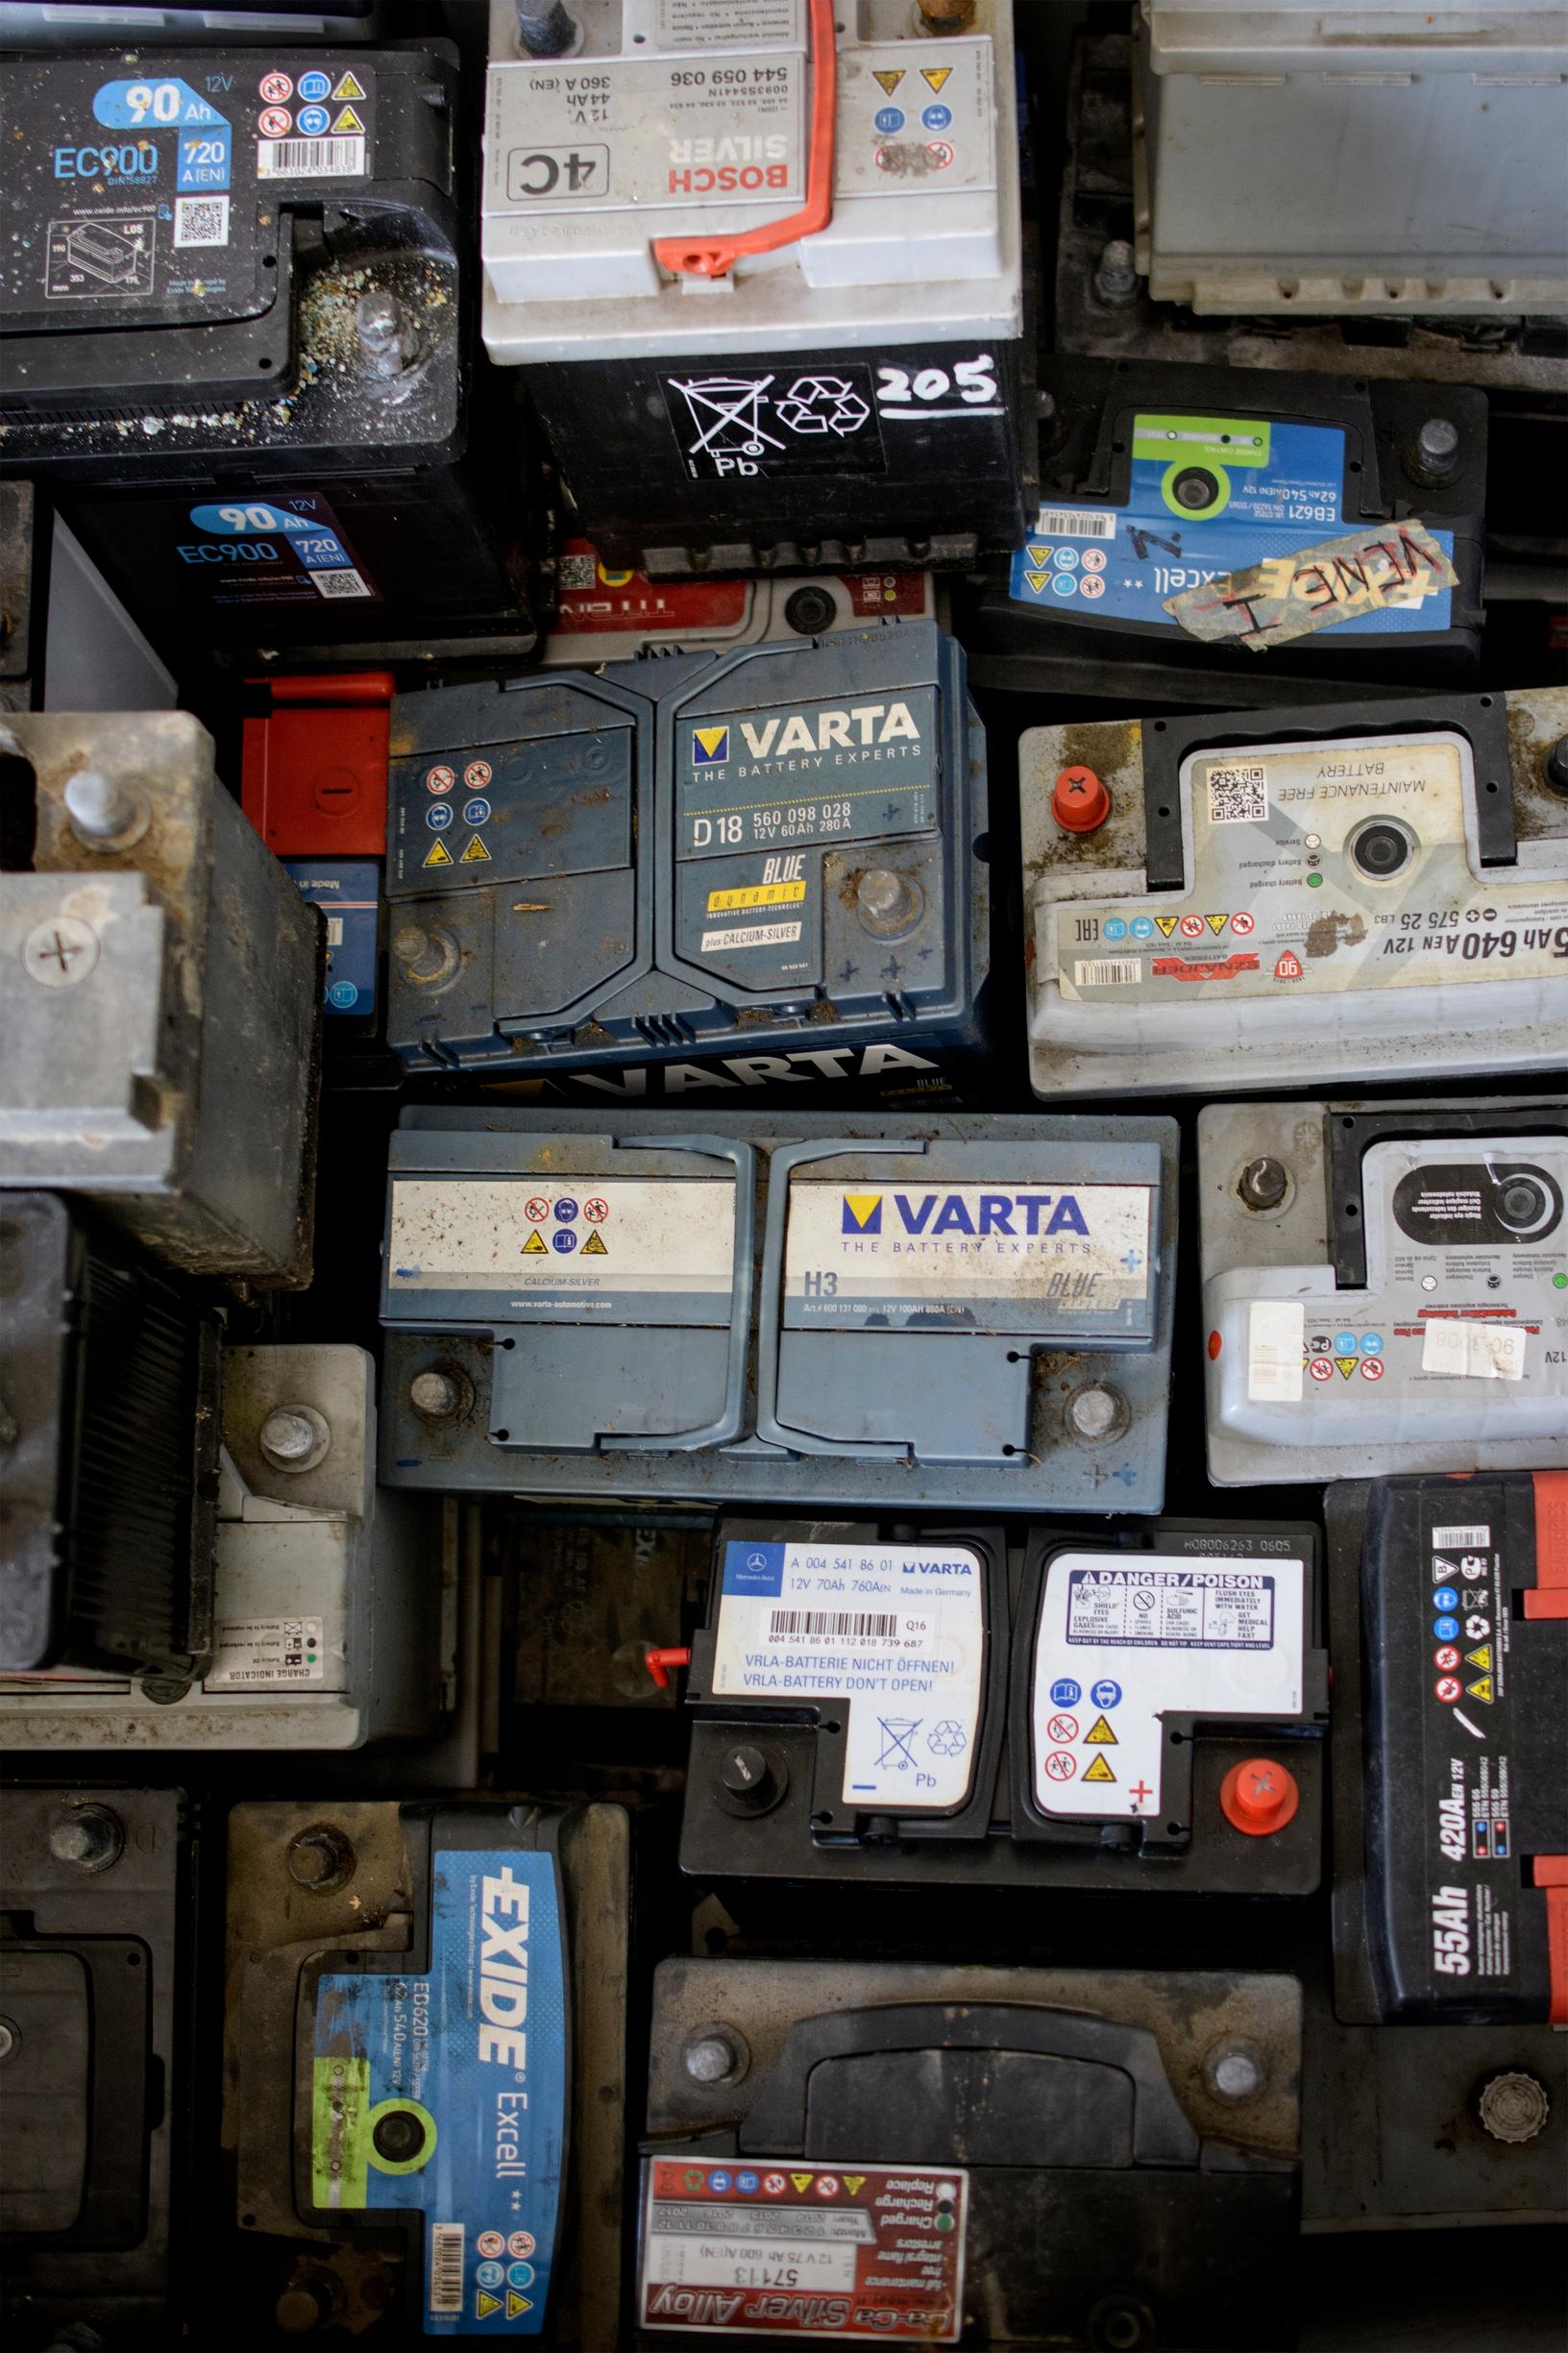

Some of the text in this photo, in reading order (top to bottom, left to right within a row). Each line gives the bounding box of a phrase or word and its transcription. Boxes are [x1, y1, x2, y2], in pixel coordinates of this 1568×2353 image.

[206, 76, 232, 92] 12V
[530, 77, 610, 90] 360 A (EN)
[671, 67, 787, 86] 544 059 036
[126, 85, 211, 122] 90 Ah
[592, 110, 607, 122] 12
[184, 142, 225, 165] 720
[671, 134, 788, 162] SILVER
[55, 146, 158, 178] EC900
[182, 169, 192, 182] A
[521, 154, 596, 195] 4C
[669, 165, 788, 193] BOSCH
[877, 355, 996, 403] 205
[716, 457, 758, 477] Pb
[289, 500, 316, 511] 12V
[1289, 505, 1335, 521] EB621
[219, 506, 308, 530] 90 Ah
[177, 543, 279, 563] EC900
[295, 539, 338, 552] 720
[306, 554, 317, 564] A
[740, 702, 920, 759] VARTA
[693, 746, 921, 783] THE BATTERY EXPERTS
[1316, 762, 1384, 777] BATTERY
[1277, 779, 1426, 800] MAINTENANCE FREE
[753, 802, 851, 828] 560 098 028
[753, 826, 775, 840] 12V
[1276, 838, 1300, 846] Service
[763, 854, 806, 884] BLUE
[1238, 858, 1301, 870] Battery discharged
[1250, 877, 1302, 889] Battery charged
[1374, 911, 1458, 930] 575 25 LB3
[706, 926, 797, 947] plus CALCIUM-SILVER
[1384, 938, 1414, 954] 12V
[1279, 960, 1298, 975] 90
[570, 1043, 941, 1097] VARTA
[894, 1194, 1090, 1236] VARTA
[842, 1242, 1090, 1255] THE BATTERY EXPERTS
[525, 1278, 600, 1287] CALCIUM-SILVER
[804, 1271, 838, 1297] H3
[1046, 1272, 1103, 1298] BLUE
[511, 1300, 612, 1309] www.varta-automotive.com
[839, 1304, 924, 1313] 131 12V 100AH
[1545, 1351, 1567, 1363] 12V
[791, 1558, 894, 1571] A 004 541 86 01
[919, 1563, 972, 1575] VARTA
[791, 1579, 845, 1591] 12V 70Ah
[1099, 1572, 1263, 1589] DANGER/POISON
[900, 1586, 922, 1595] Made
[935, 1588, 971, 1598] Germany
[906, 1620, 926, 1631] Q16
[769, 1635, 922, 1648] 004 541 86 01 112 018 739 687
[745, 1654, 954, 1674] VRLA-BATTERIE NICHT ÖFFNEN!
[230, 1669, 310, 1679] CHARGE INDICATOR
[744, 1674, 933, 1692] VRLA-BATTERY DON'T OPEN!
[1451, 1758, 1464, 1779] 12V
[916, 1773, 937, 1787] Pb
[1433, 1885, 1470, 1975] 55Ah
[478, 1867, 530, 2179] EXIDE Excell
[392, 2070, 403, 2085] 12V
[886, 2179, 935, 2193] Replace
[874, 2195, 933, 2212] Recharge
[659, 2206, 689, 2218] 2017
[880, 2214, 933, 2229] Charged
[896, 2238, 943, 2249] arrestors
[740, 2249, 833, 2264] 12 V 75 Ah 600
[876, 2250, 943, 2264] integral flame
[734, 2267, 799, 2286] 57113
[921, 2266, 942, 2276] free
[865, 2276, 942, 2291] full maintenance
[648, 2284, 950, 2330] Ca-Ca Silver Alloy
